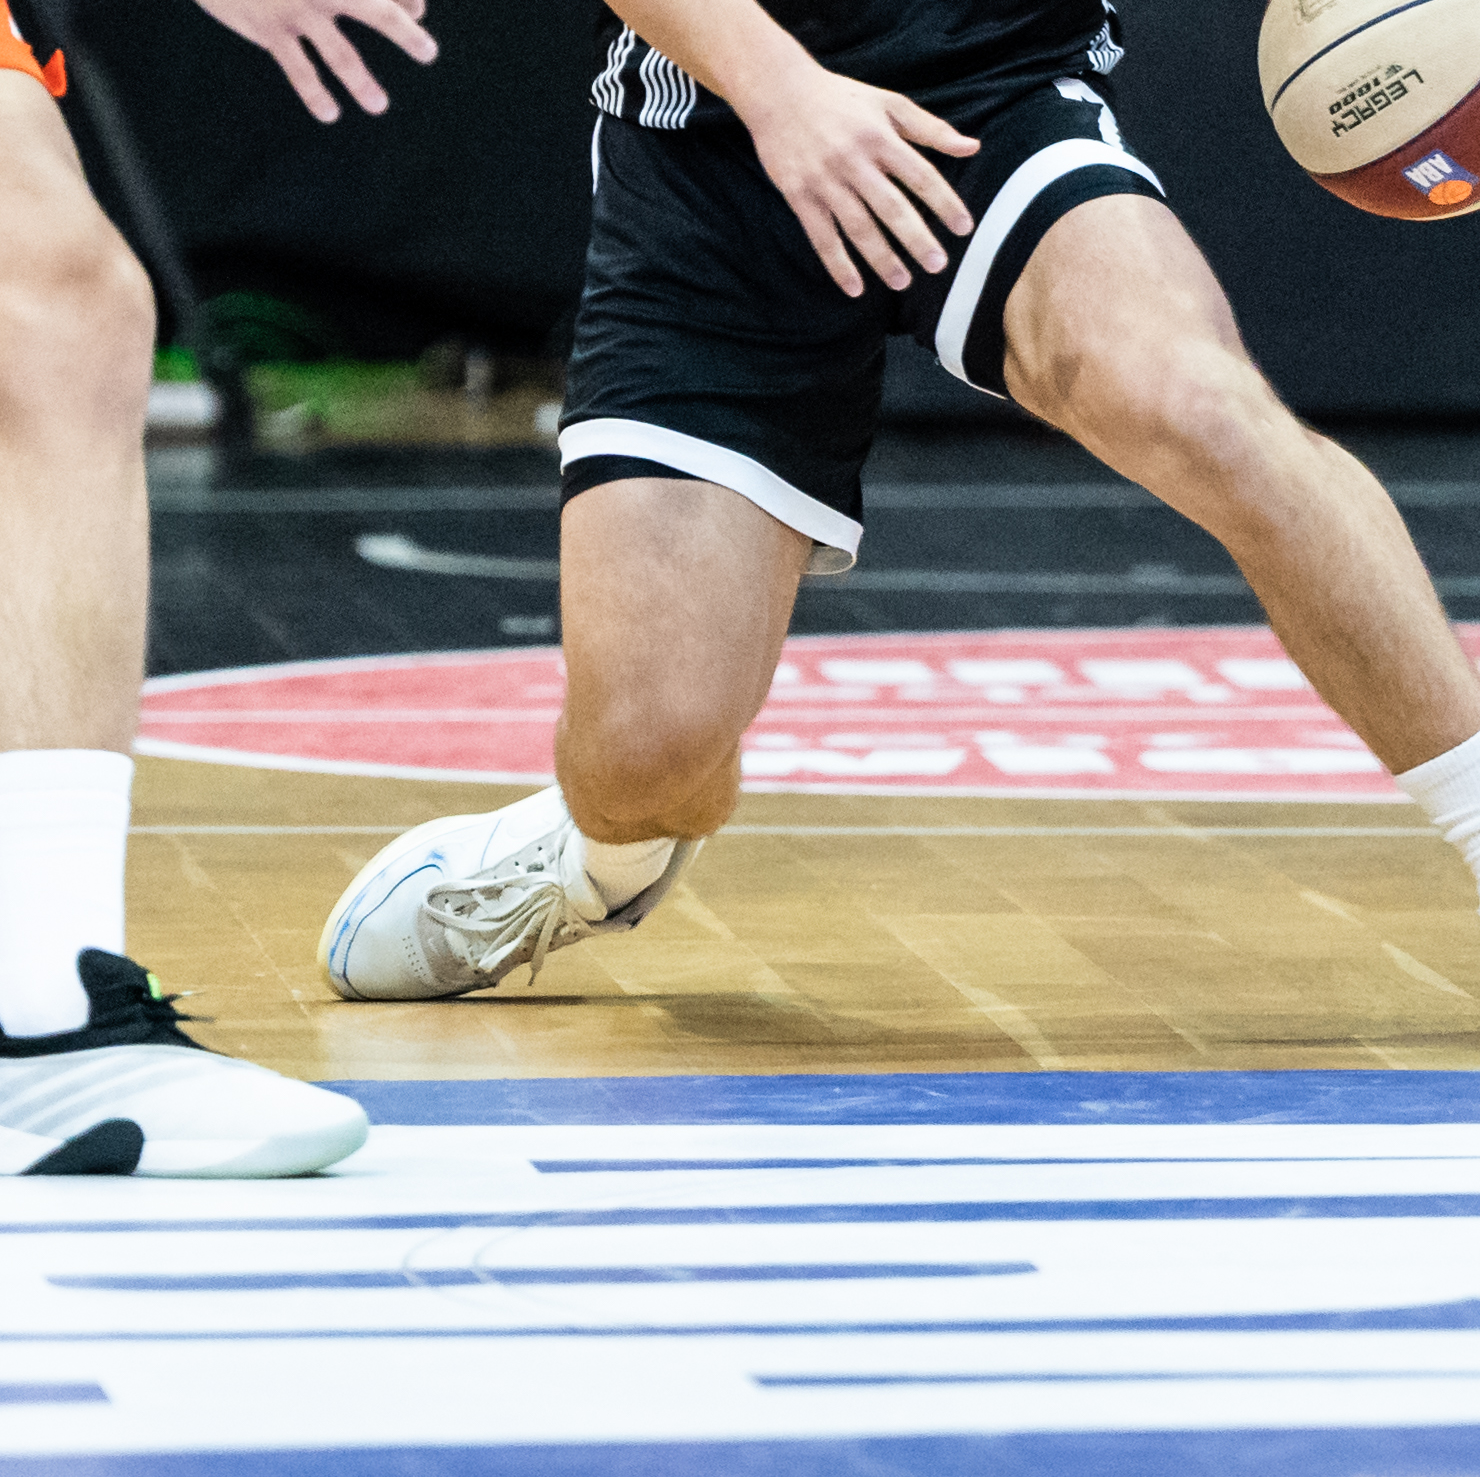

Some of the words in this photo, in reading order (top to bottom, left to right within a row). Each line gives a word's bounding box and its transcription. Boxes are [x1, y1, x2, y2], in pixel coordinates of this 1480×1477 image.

[1328, 77, 1381, 115] 1000
[1332, 69, 1424, 138] LEGACY
[1404, 153, 1453, 188] ABA
